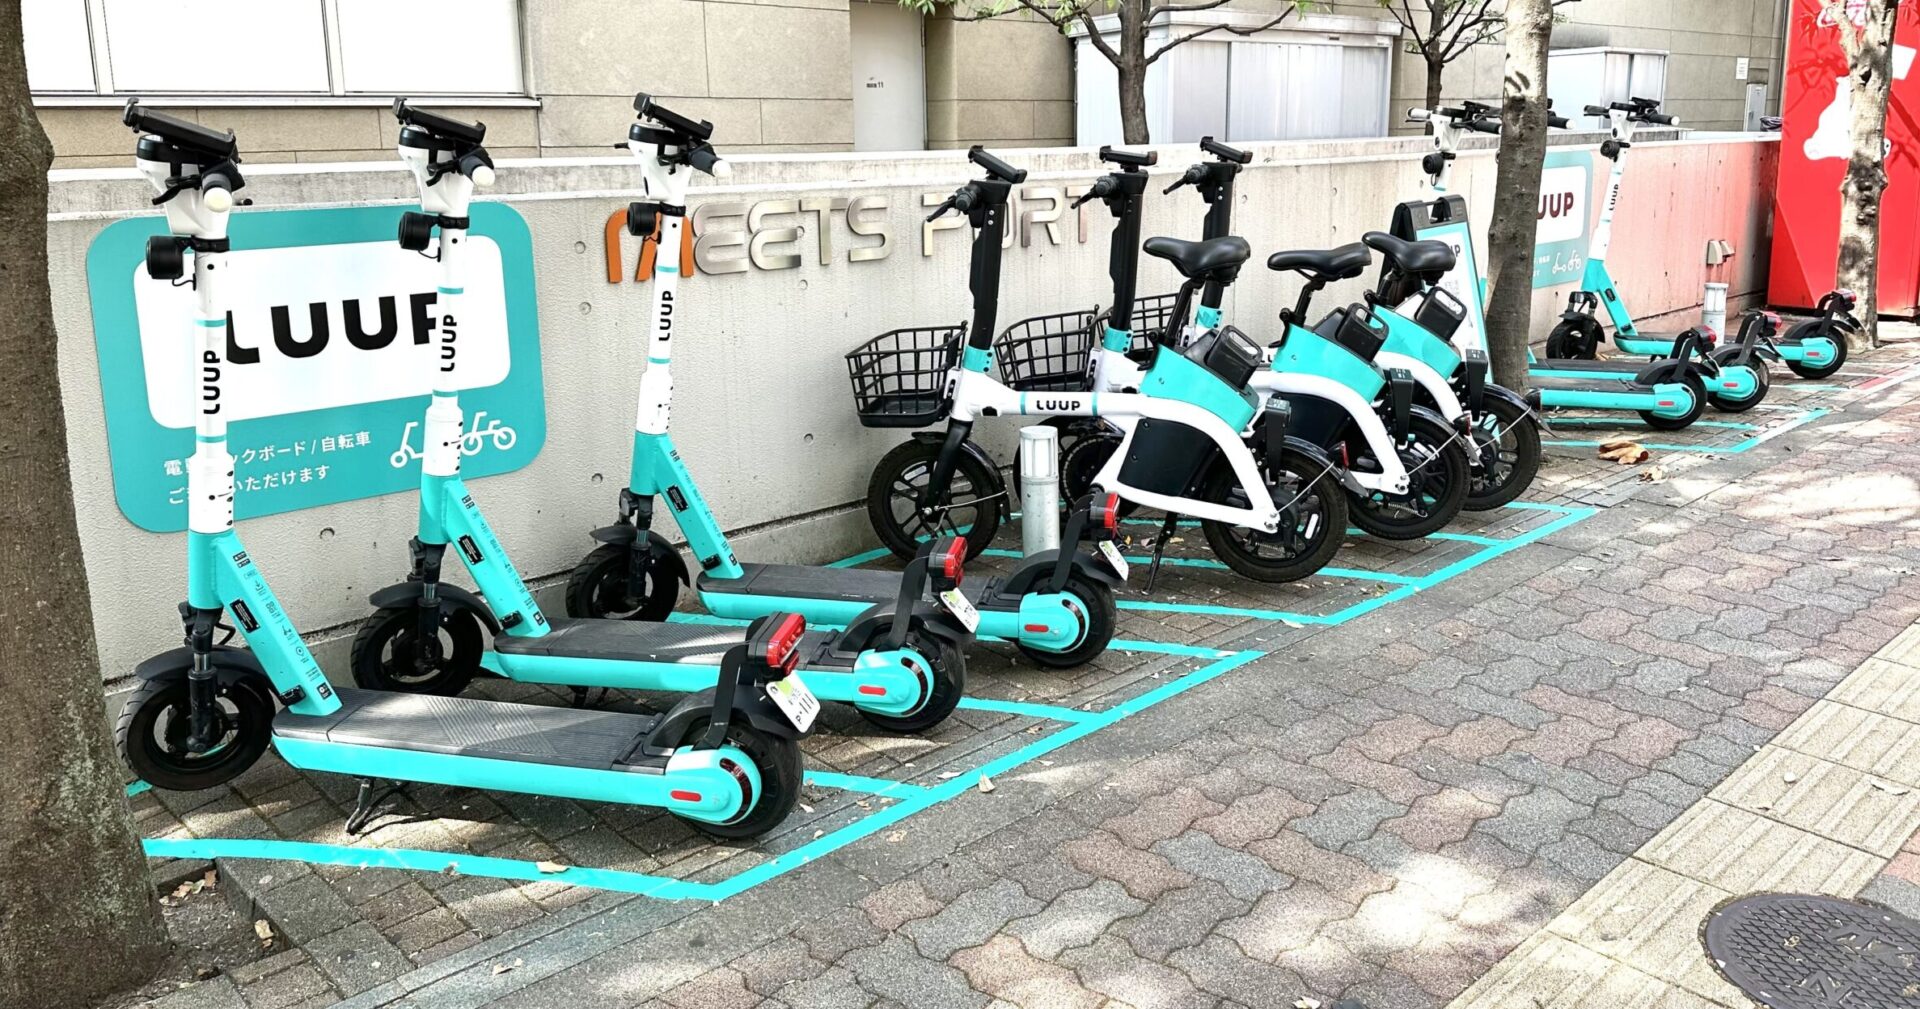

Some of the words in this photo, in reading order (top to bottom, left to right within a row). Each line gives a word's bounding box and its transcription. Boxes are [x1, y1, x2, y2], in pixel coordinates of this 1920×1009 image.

[922, 187, 1096, 257] PRT
[1536, 192, 1574, 220] UUP
[659, 290, 673, 341] LUUP
[440, 314, 457, 372] LUUP
[203, 350, 220, 415] LUUP
[1036, 400, 1081, 411] LUUP
